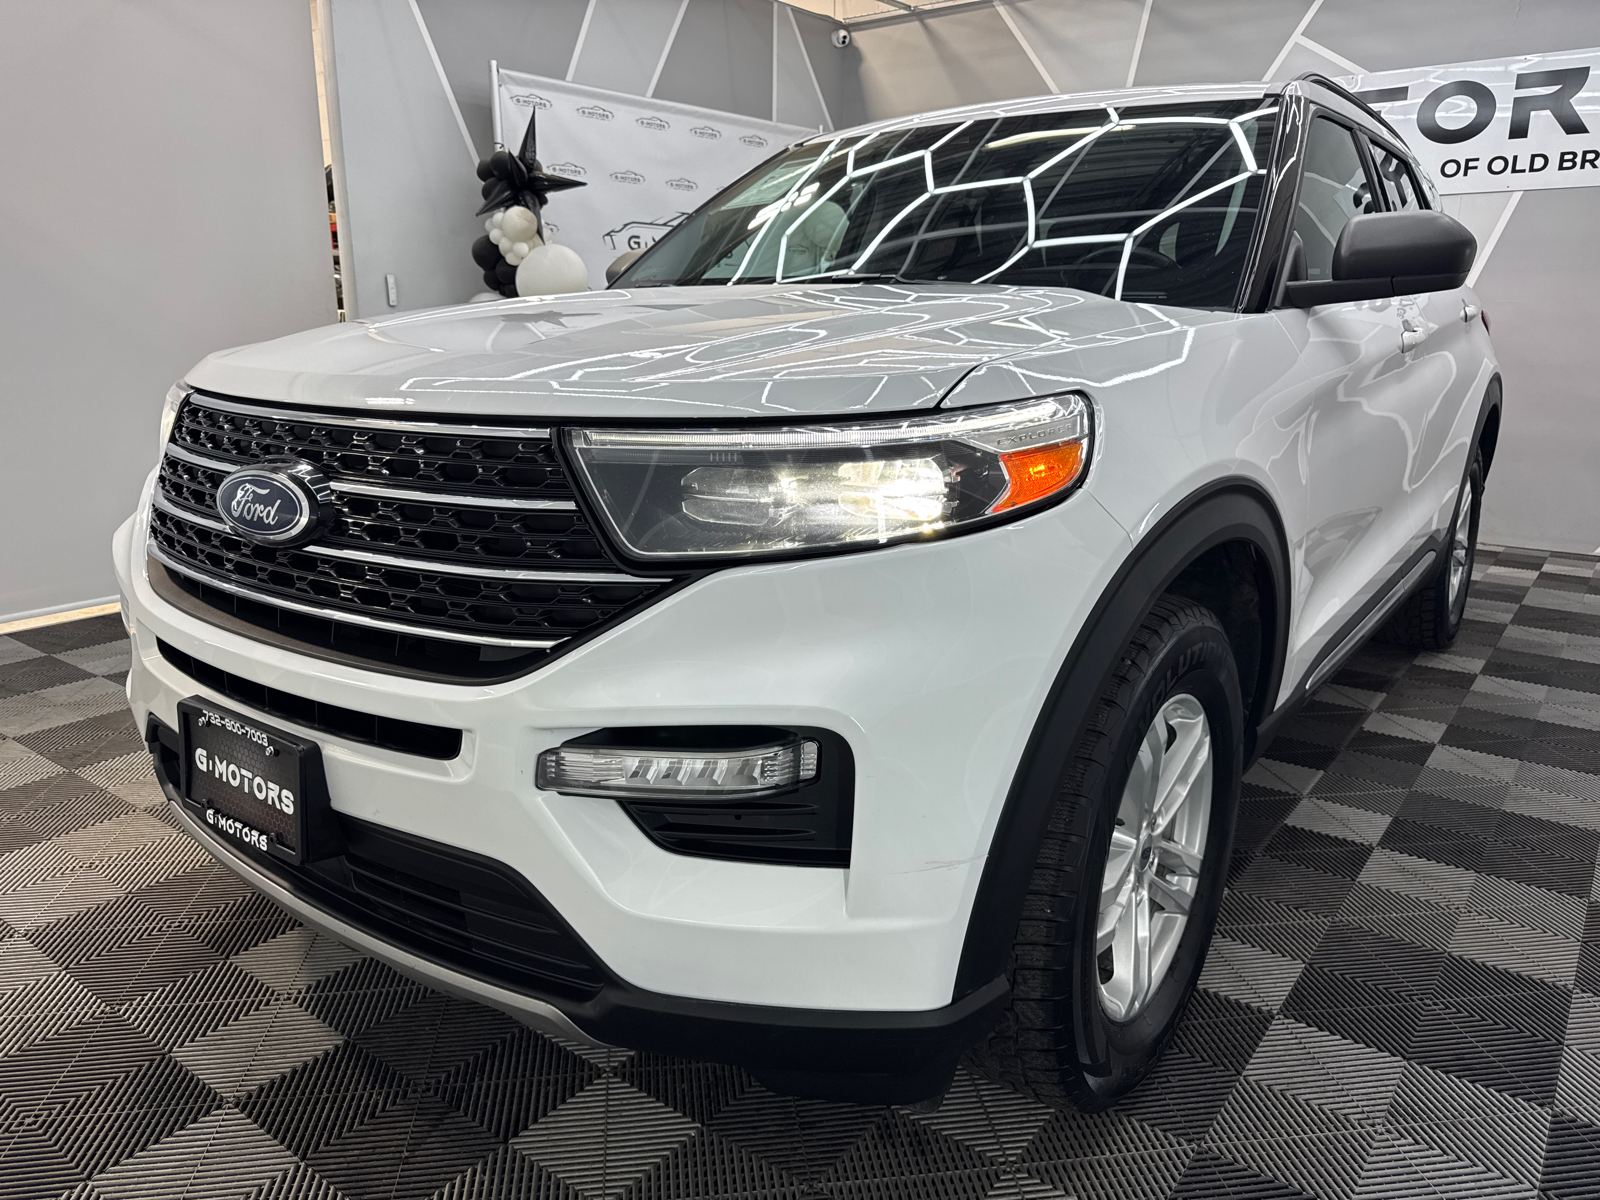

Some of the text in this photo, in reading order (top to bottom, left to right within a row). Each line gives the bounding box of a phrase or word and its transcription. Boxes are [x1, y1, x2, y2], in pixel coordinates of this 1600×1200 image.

[1439, 149, 1600, 178] OF OLD BR
[996, 423, 1072, 447] EXPLORER
[231, 482, 281, 525] Ford
[202, 709, 269, 747] 732-800-7003
